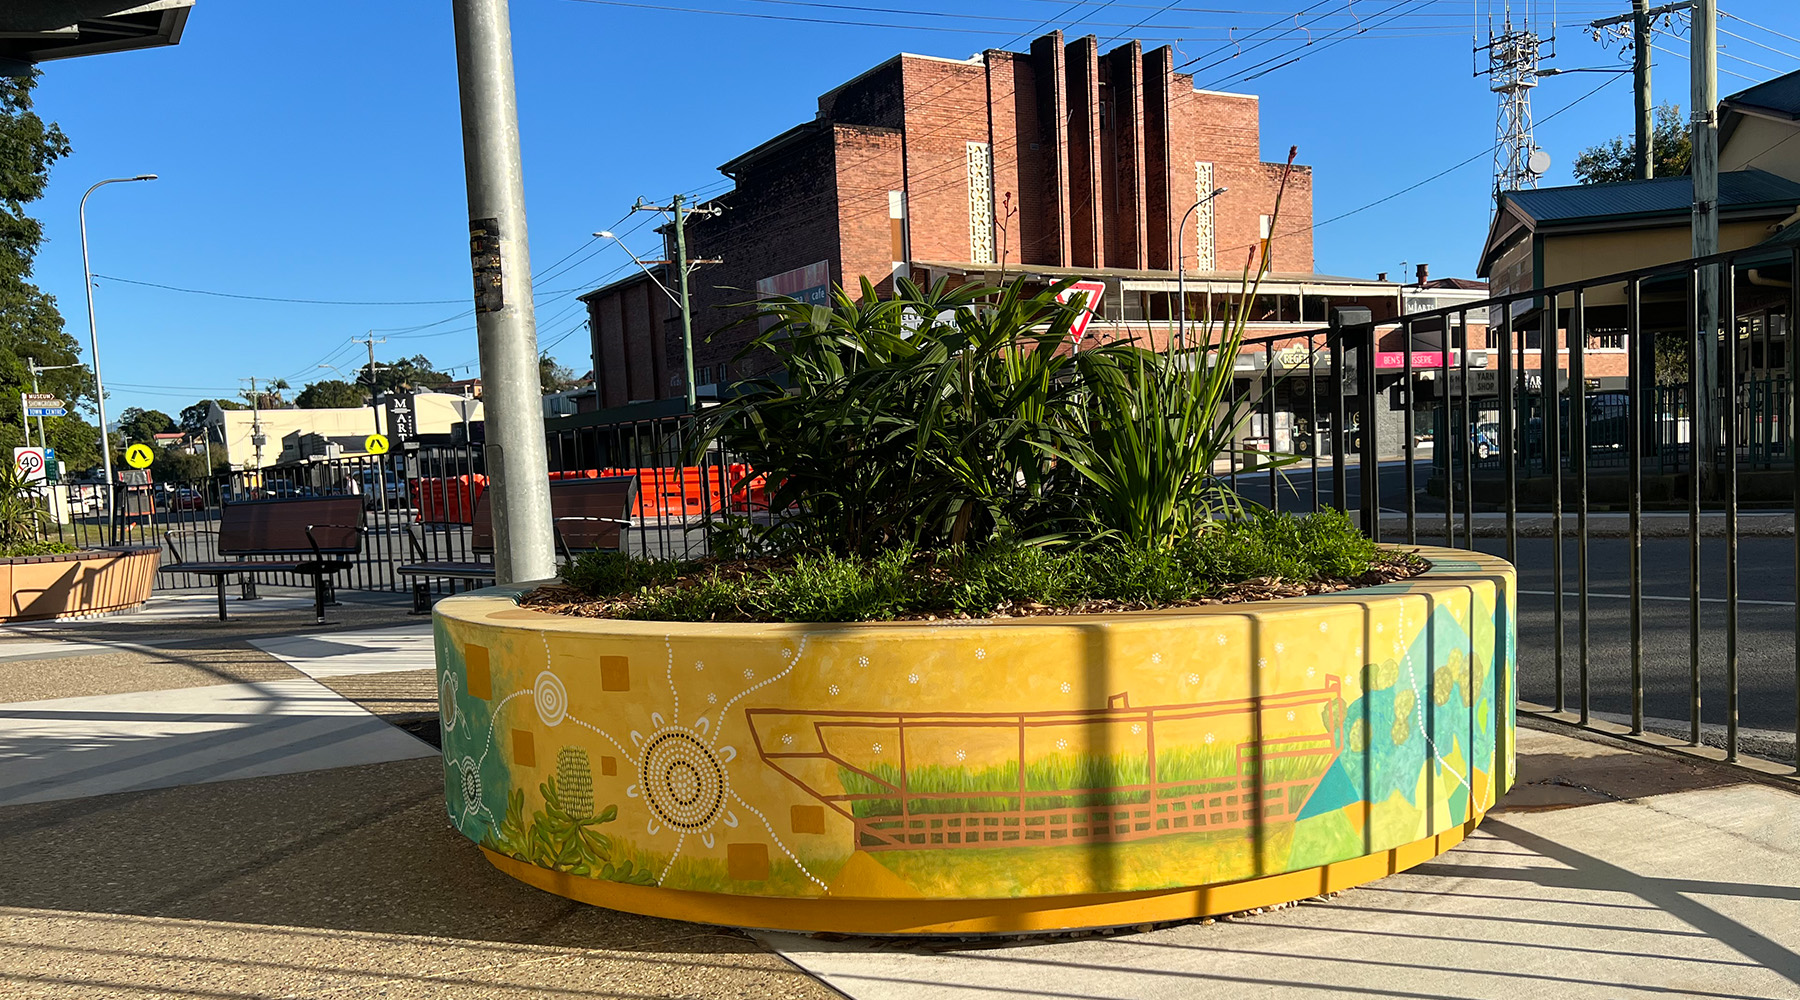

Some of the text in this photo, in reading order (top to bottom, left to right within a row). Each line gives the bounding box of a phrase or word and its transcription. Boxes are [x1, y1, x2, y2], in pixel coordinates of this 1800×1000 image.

[811, 288, 825, 300] cafe
[1283, 353, 1309, 364] REGEN
[1383, 356, 1400, 365] BEN'S
[1477, 383, 1494, 391] SHOP
[21, 457, 39, 467] 40
